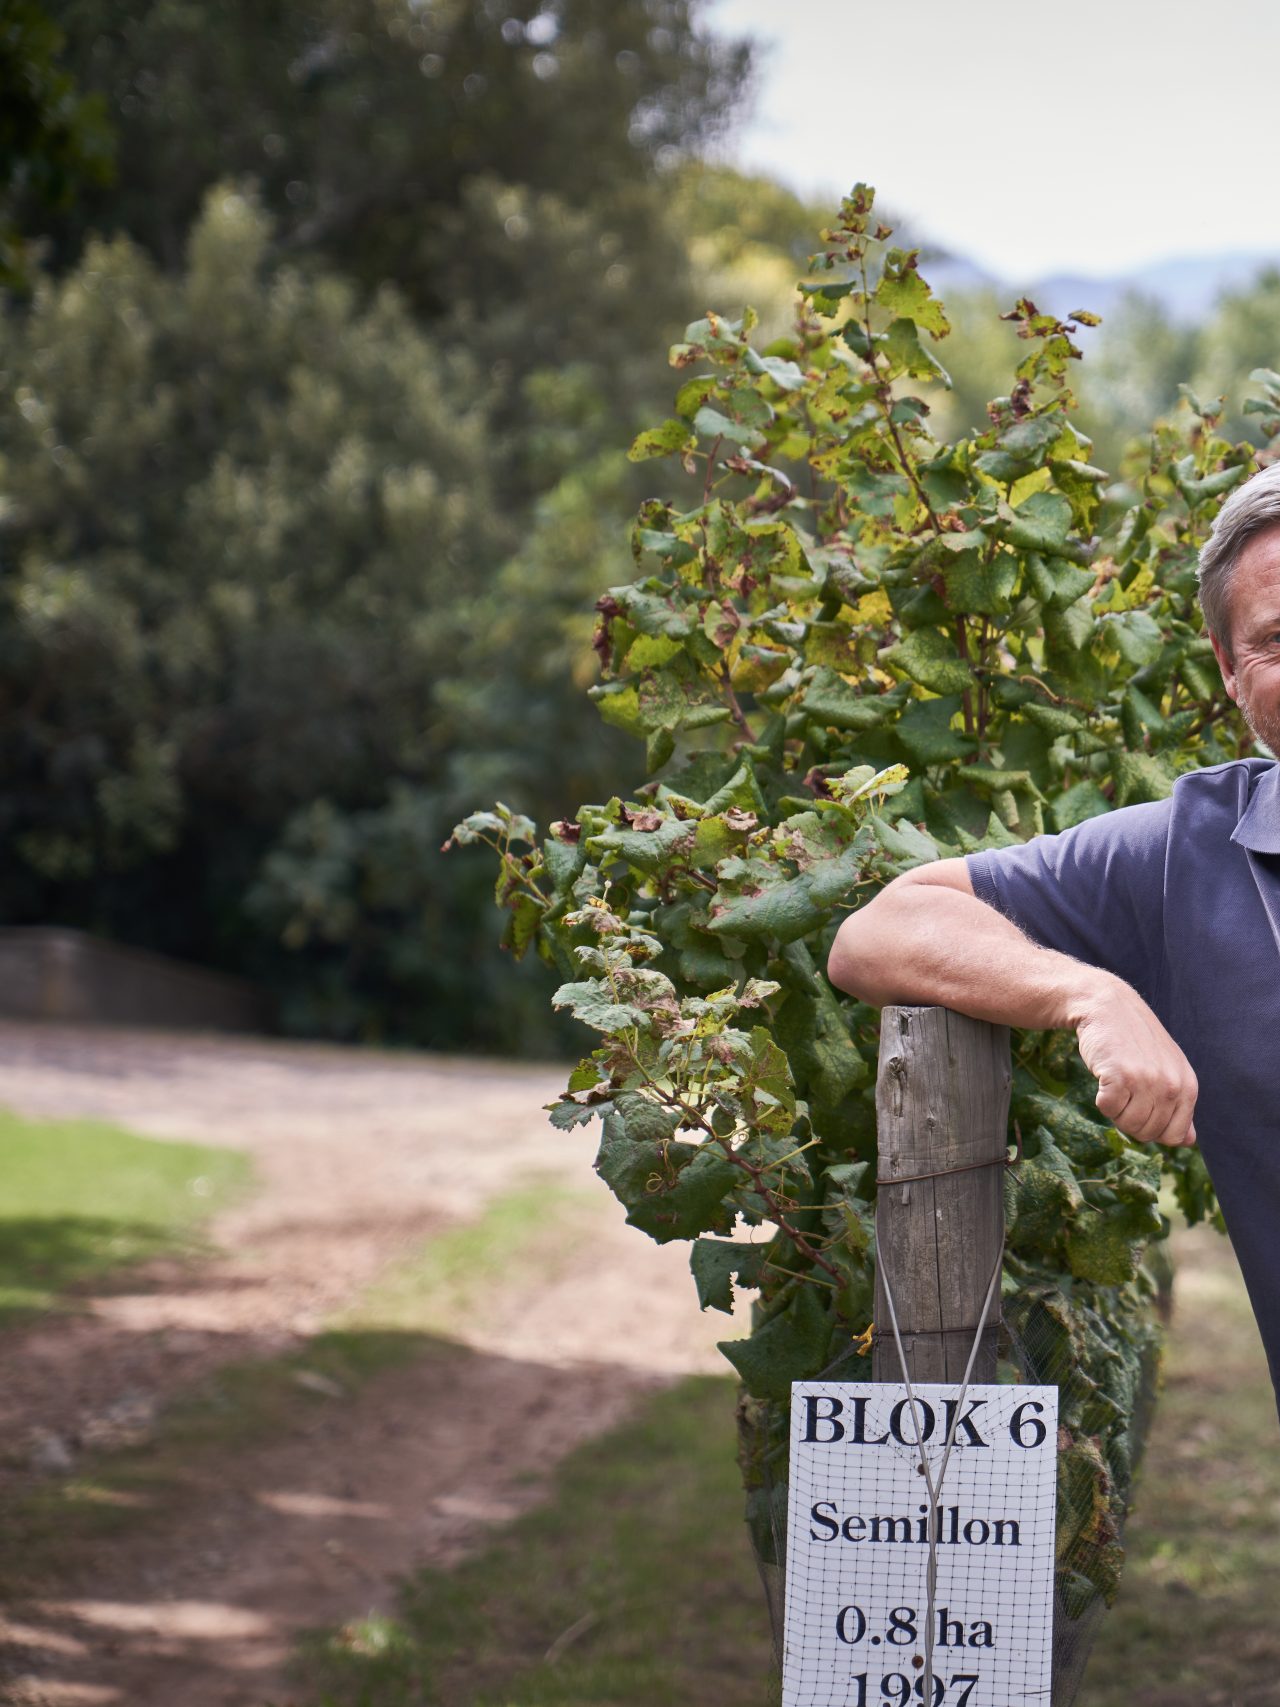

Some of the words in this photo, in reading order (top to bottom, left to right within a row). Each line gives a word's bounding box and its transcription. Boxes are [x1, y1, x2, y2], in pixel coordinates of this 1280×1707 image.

[799, 1395, 990, 1448] BLOK
[1009, 1401, 1047, 1449] 6
[809, 1501, 1022, 1546] Semillon
[836, 1605, 918, 1646] 0.8
[936, 1608, 995, 1648] ha
[851, 1672, 979, 1707] 1997
